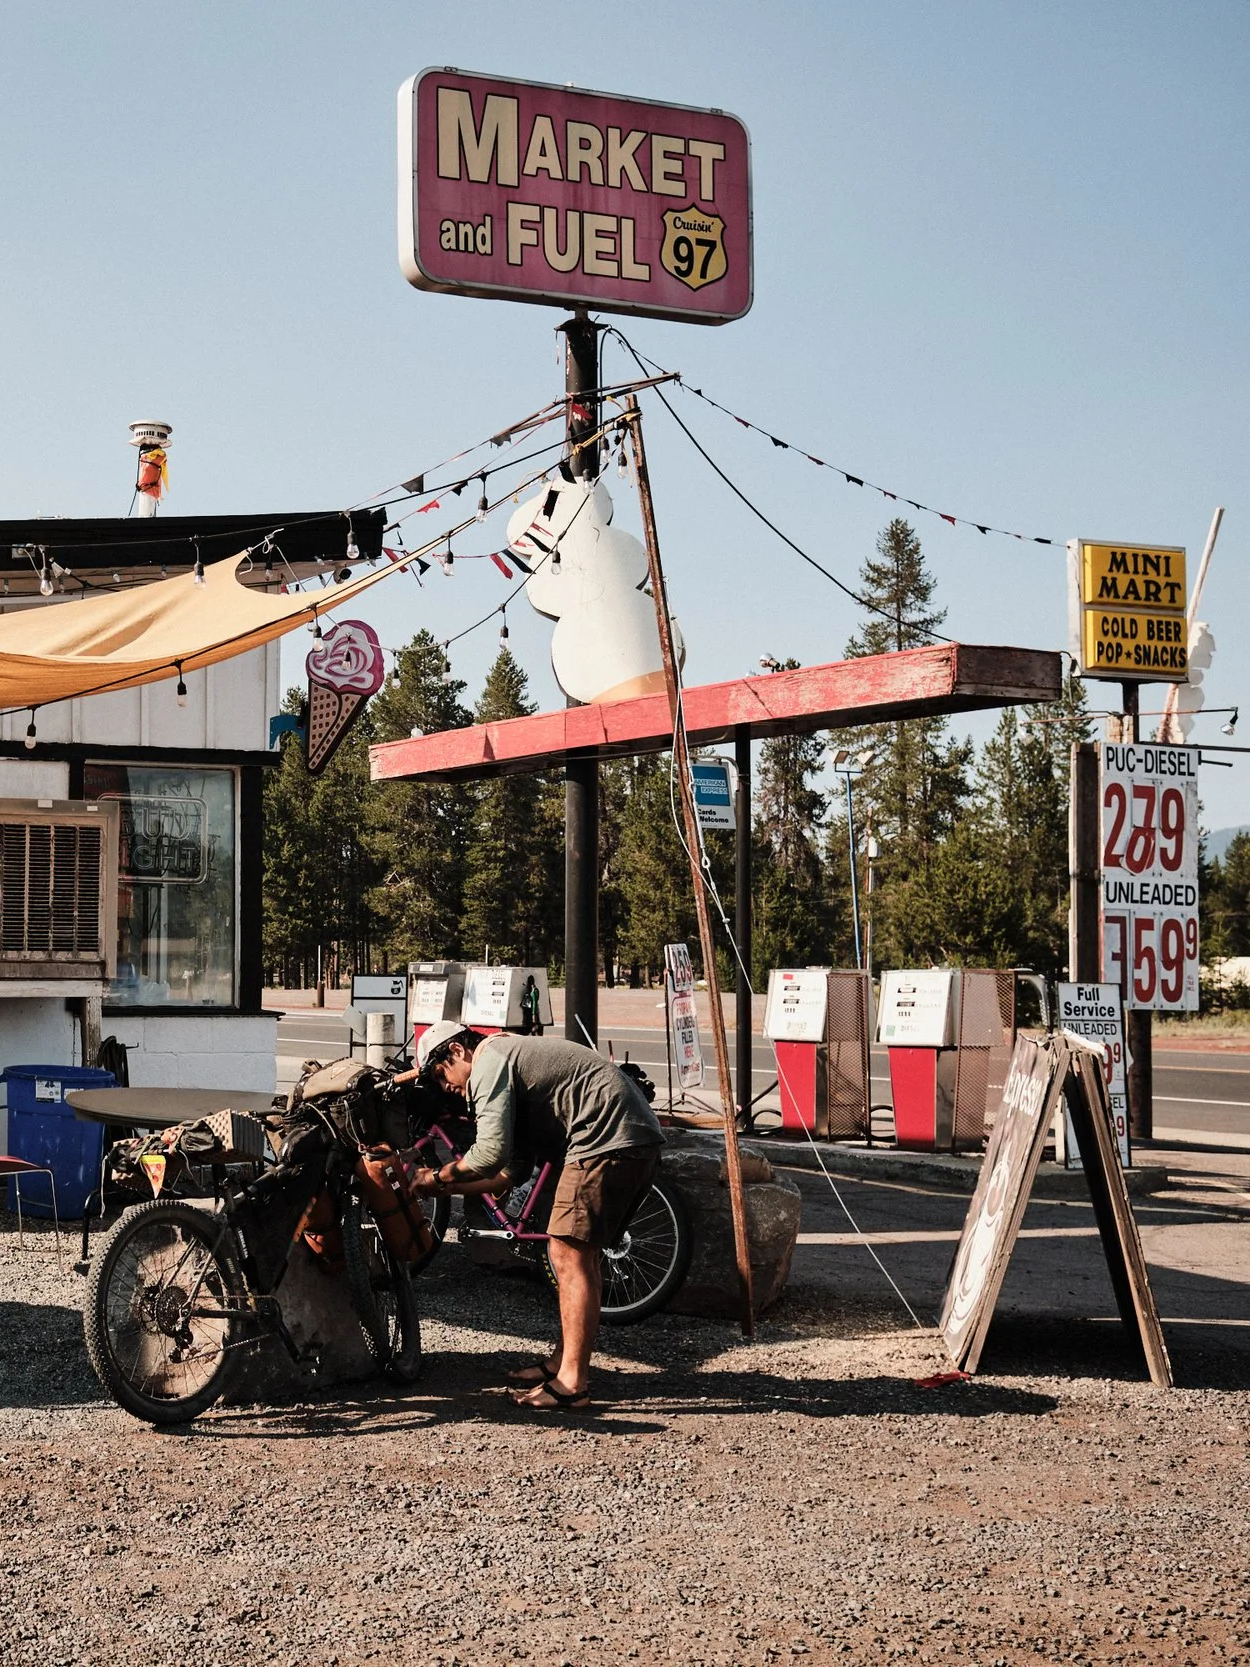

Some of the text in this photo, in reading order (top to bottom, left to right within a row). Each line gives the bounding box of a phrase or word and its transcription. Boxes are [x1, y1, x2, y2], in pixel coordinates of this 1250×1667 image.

[436, 86, 726, 202] MARKET
[440, 201, 651, 282] and FUEL
[673, 236, 718, 280] 97
[1107, 551, 1172, 578] MINI
[1097, 576, 1182, 604] MART
[1101, 615, 1182, 643] COLD BEER
[1106, 746, 1196, 777] PUC-DIESEL
[1105, 882, 1197, 907] UNLEADED
[1077, 986, 1100, 1002] Full
[1063, 1001, 1116, 1018] Service
